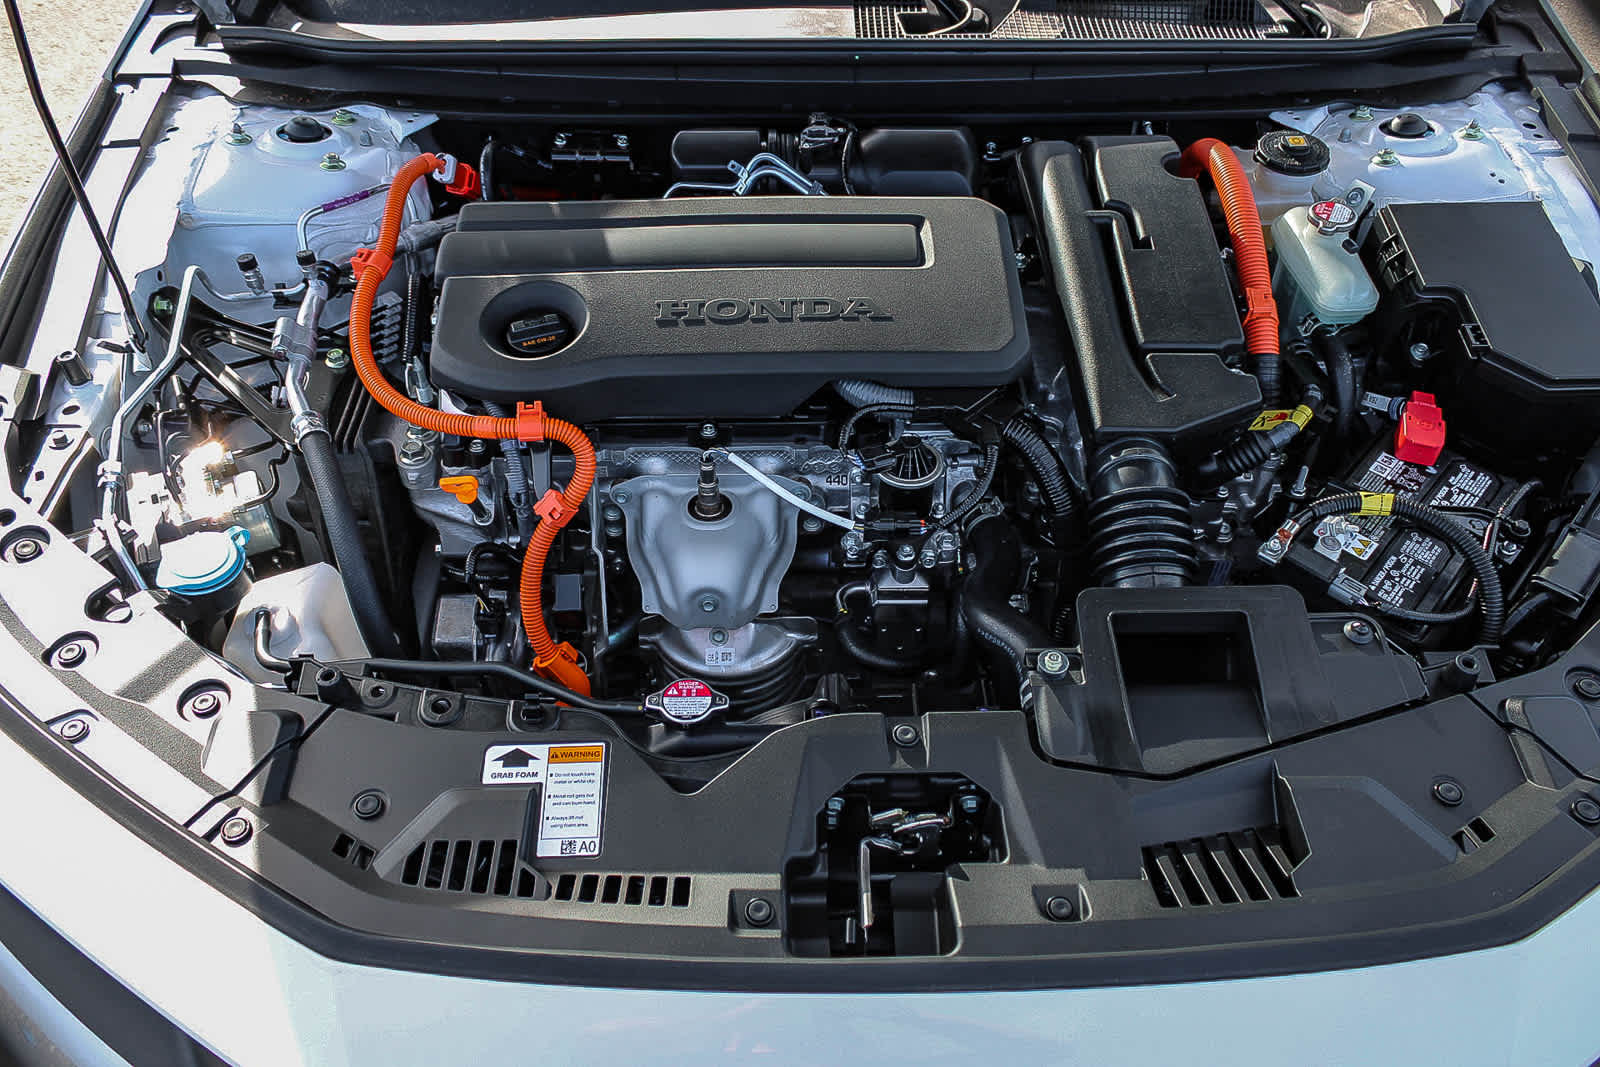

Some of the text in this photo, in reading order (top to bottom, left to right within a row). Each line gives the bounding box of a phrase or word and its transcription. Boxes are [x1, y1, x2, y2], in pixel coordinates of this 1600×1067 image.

[654, 297, 894, 325] HONDA
[826, 474, 848, 486] 440
[560, 750, 601, 759] WARNING
[490, 771, 539, 780] GRAB FOAM
[578, 840, 597, 853] A0
